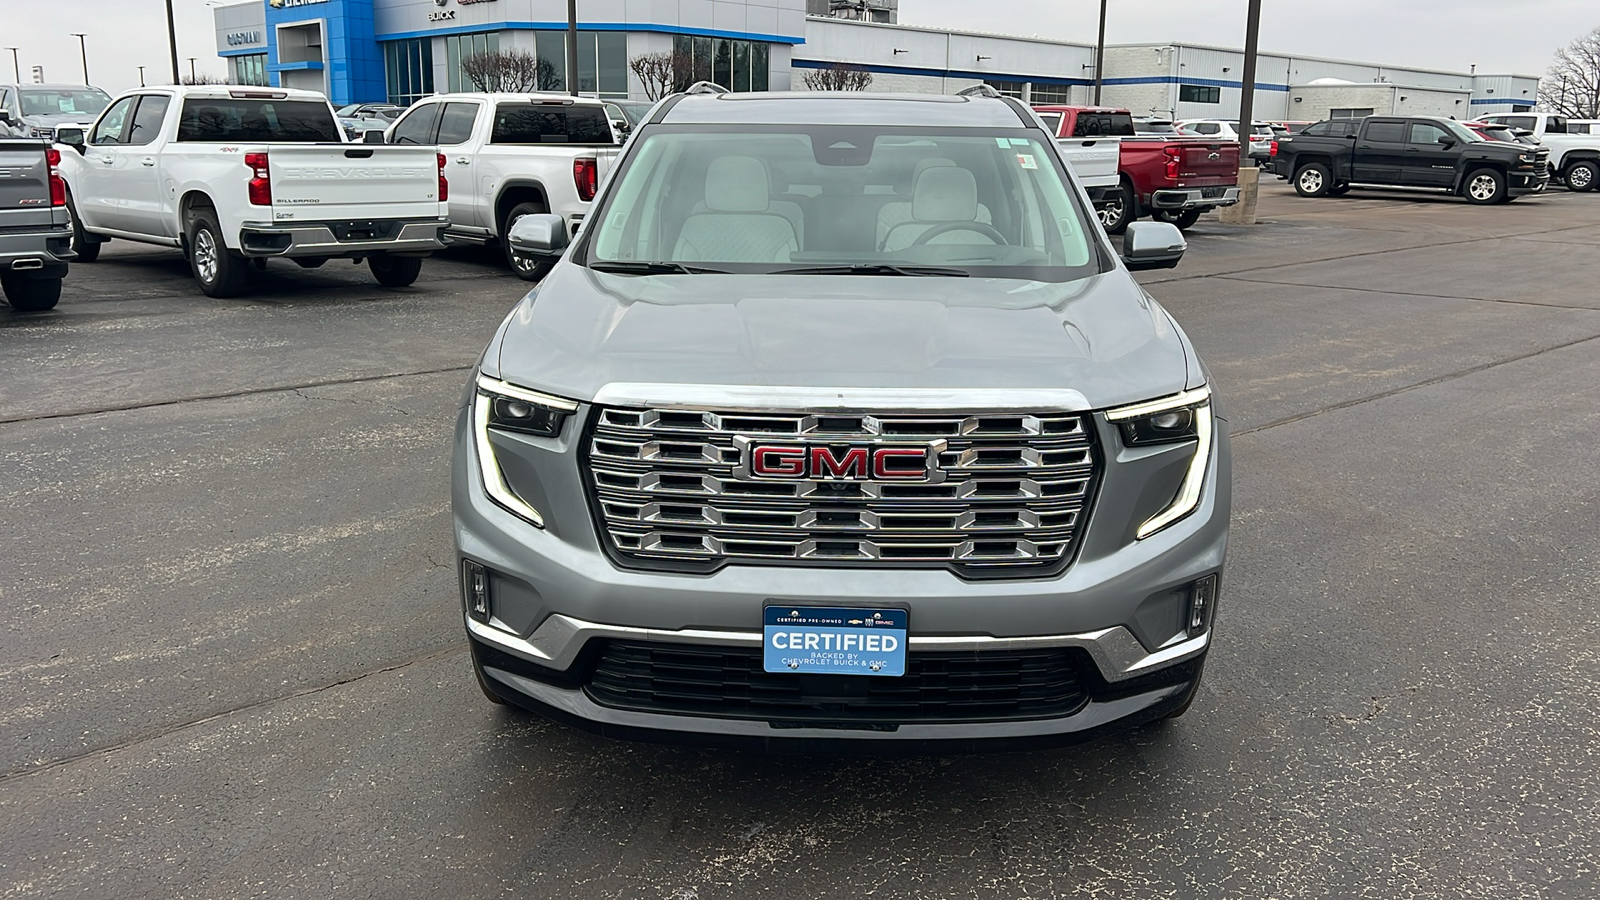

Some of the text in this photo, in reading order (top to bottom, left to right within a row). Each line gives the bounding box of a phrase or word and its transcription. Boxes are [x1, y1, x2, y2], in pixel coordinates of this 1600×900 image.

[428, 10, 455, 21] BUICK
[284, 167, 429, 179] CHEVROLET
[753, 445, 927, 479] GMC
[771, 631, 898, 653] CERTIFIED
[810, 652, 845, 660] BACKED
[781, 657, 831, 666] CHEVROLET
[833, 659, 859, 667] BUICK
[869, 660, 888, 668] GMC
